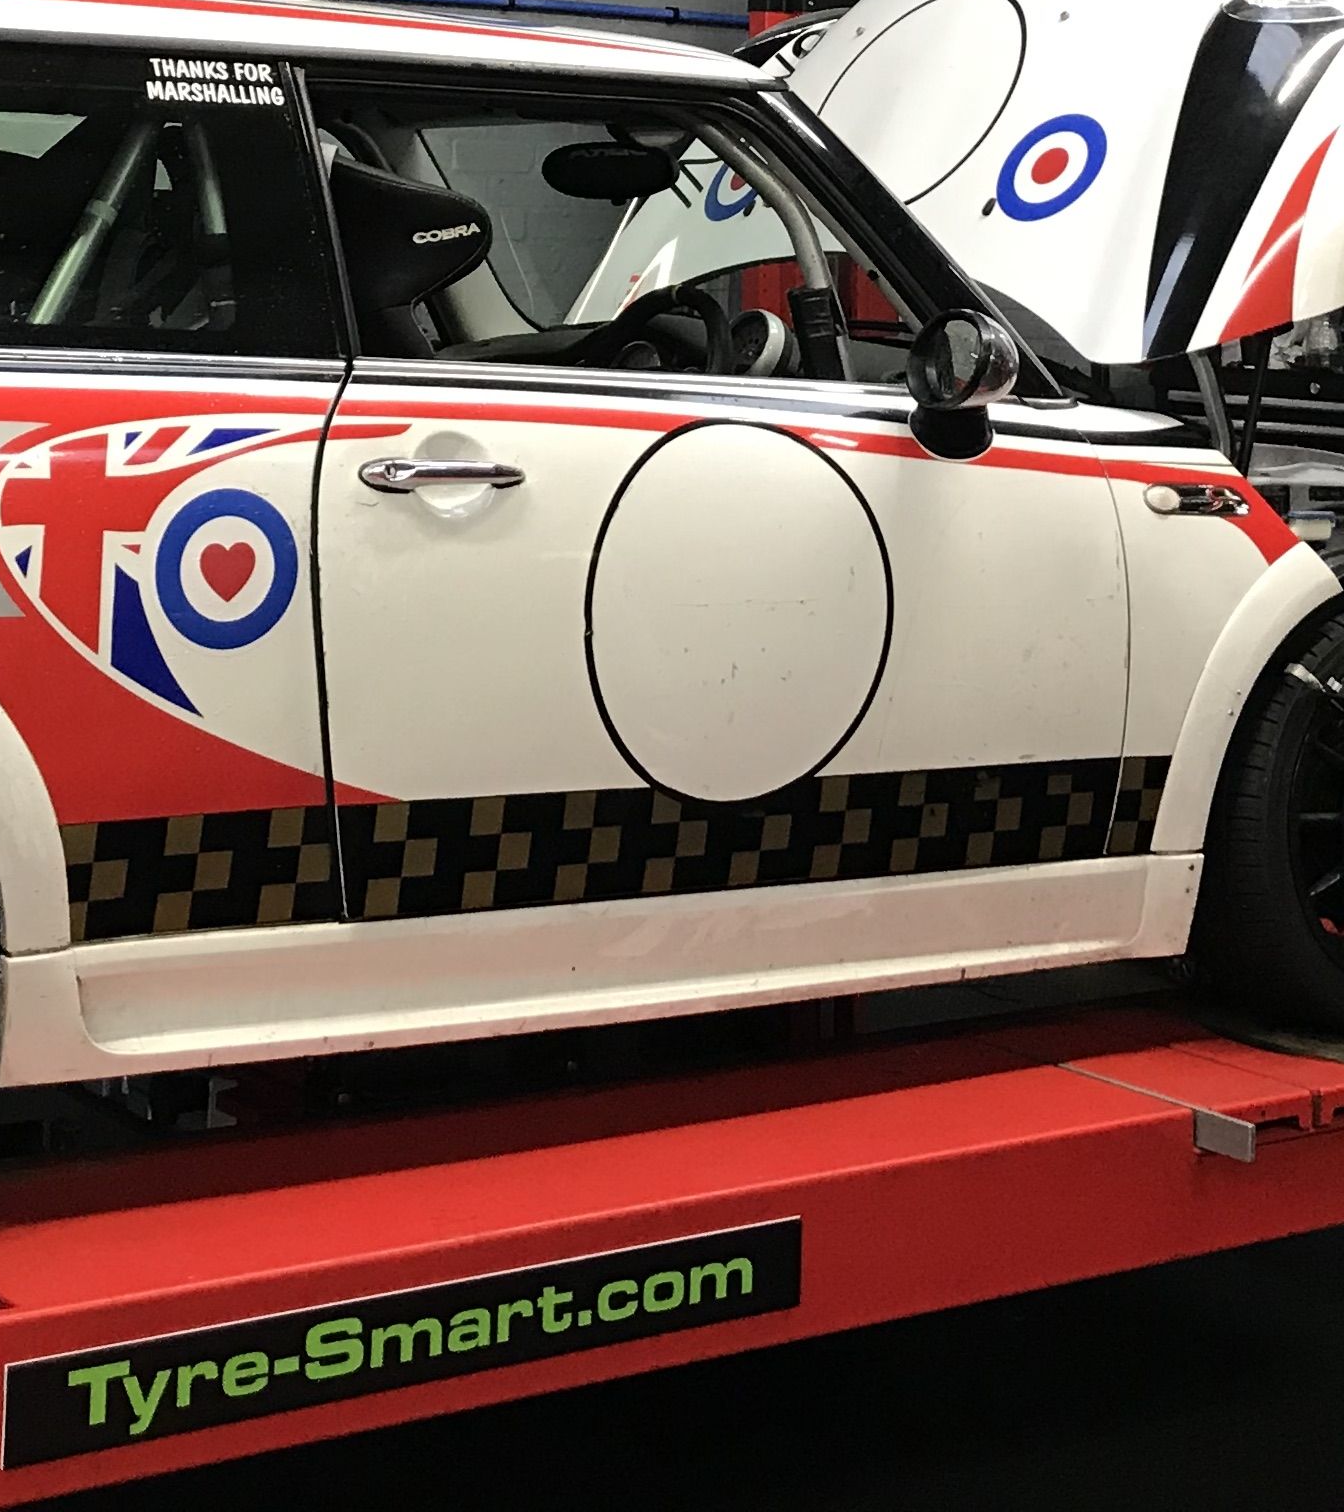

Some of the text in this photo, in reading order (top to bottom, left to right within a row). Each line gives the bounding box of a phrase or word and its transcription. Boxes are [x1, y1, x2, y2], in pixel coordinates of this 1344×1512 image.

[149, 58, 274, 84] THANKS FOR
[145, 81, 285, 106] MARSHALLING
[412, 222, 481, 244] COBRA
[67, 1256, 754, 1435] Tyre-Smart.com
